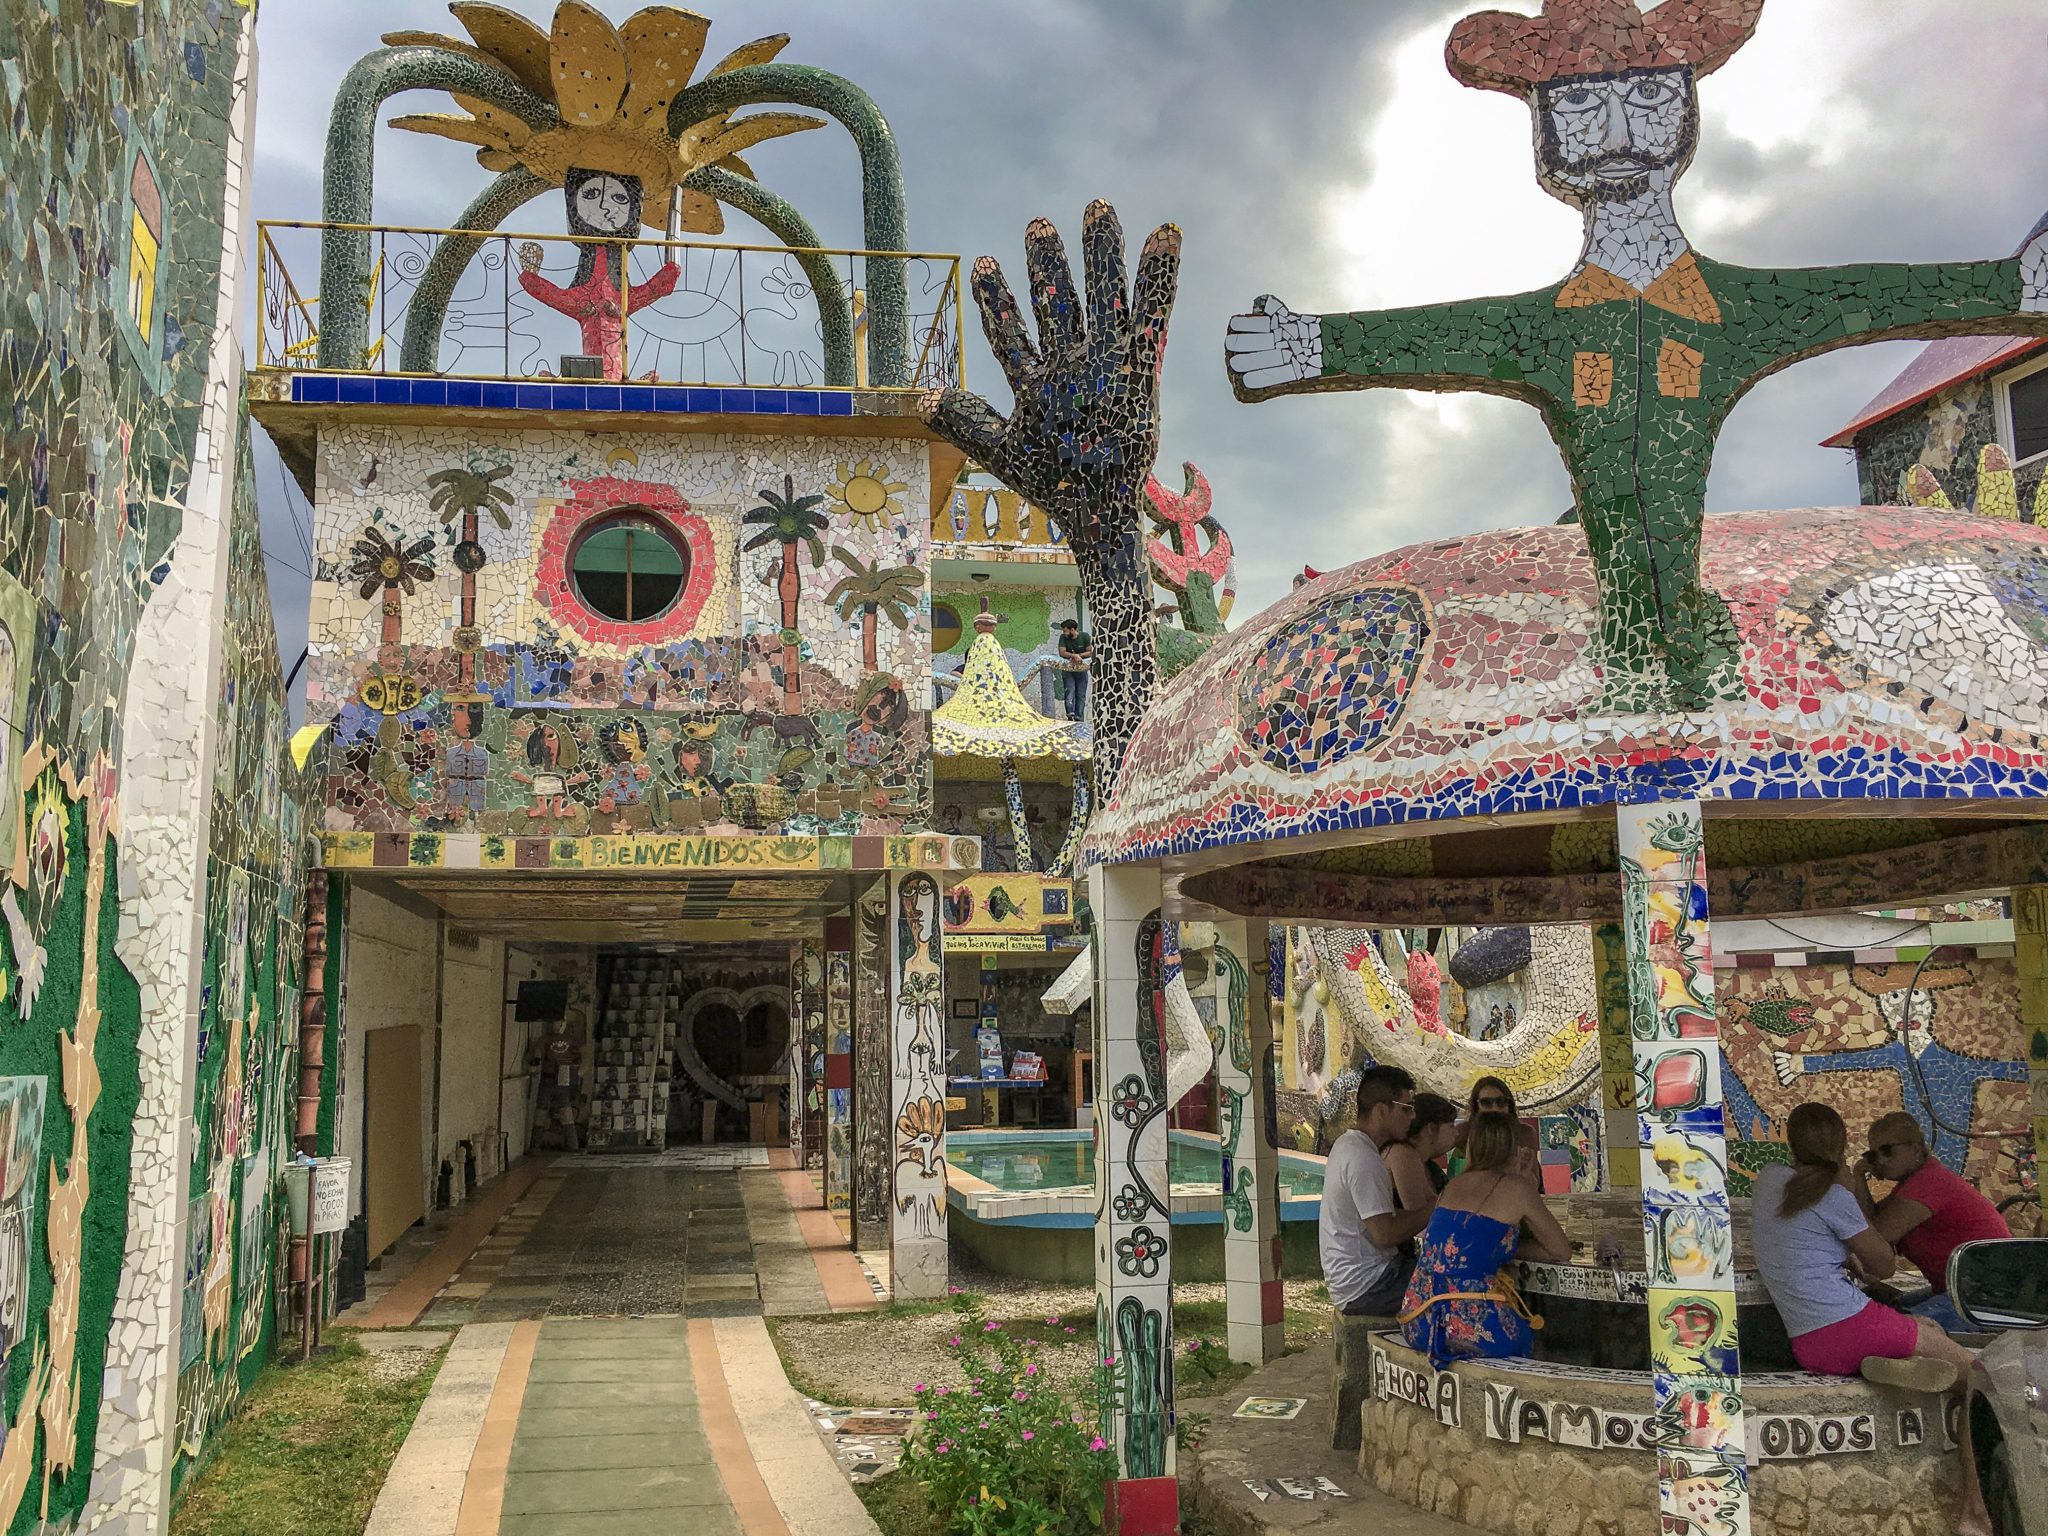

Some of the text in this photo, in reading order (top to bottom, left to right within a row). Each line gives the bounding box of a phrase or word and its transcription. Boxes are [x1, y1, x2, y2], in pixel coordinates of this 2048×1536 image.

[318, 1179, 339, 1189] FAVOR
[316, 1191, 327, 1201] NO
[320, 1198, 344, 1211] COCOS
[1374, 1350, 1460, 1427] AHORA
[1486, 1382, 1657, 1450] VAMOS
[1744, 1408, 1873, 1457] ODOS
[1901, 1409, 1922, 1443] A
